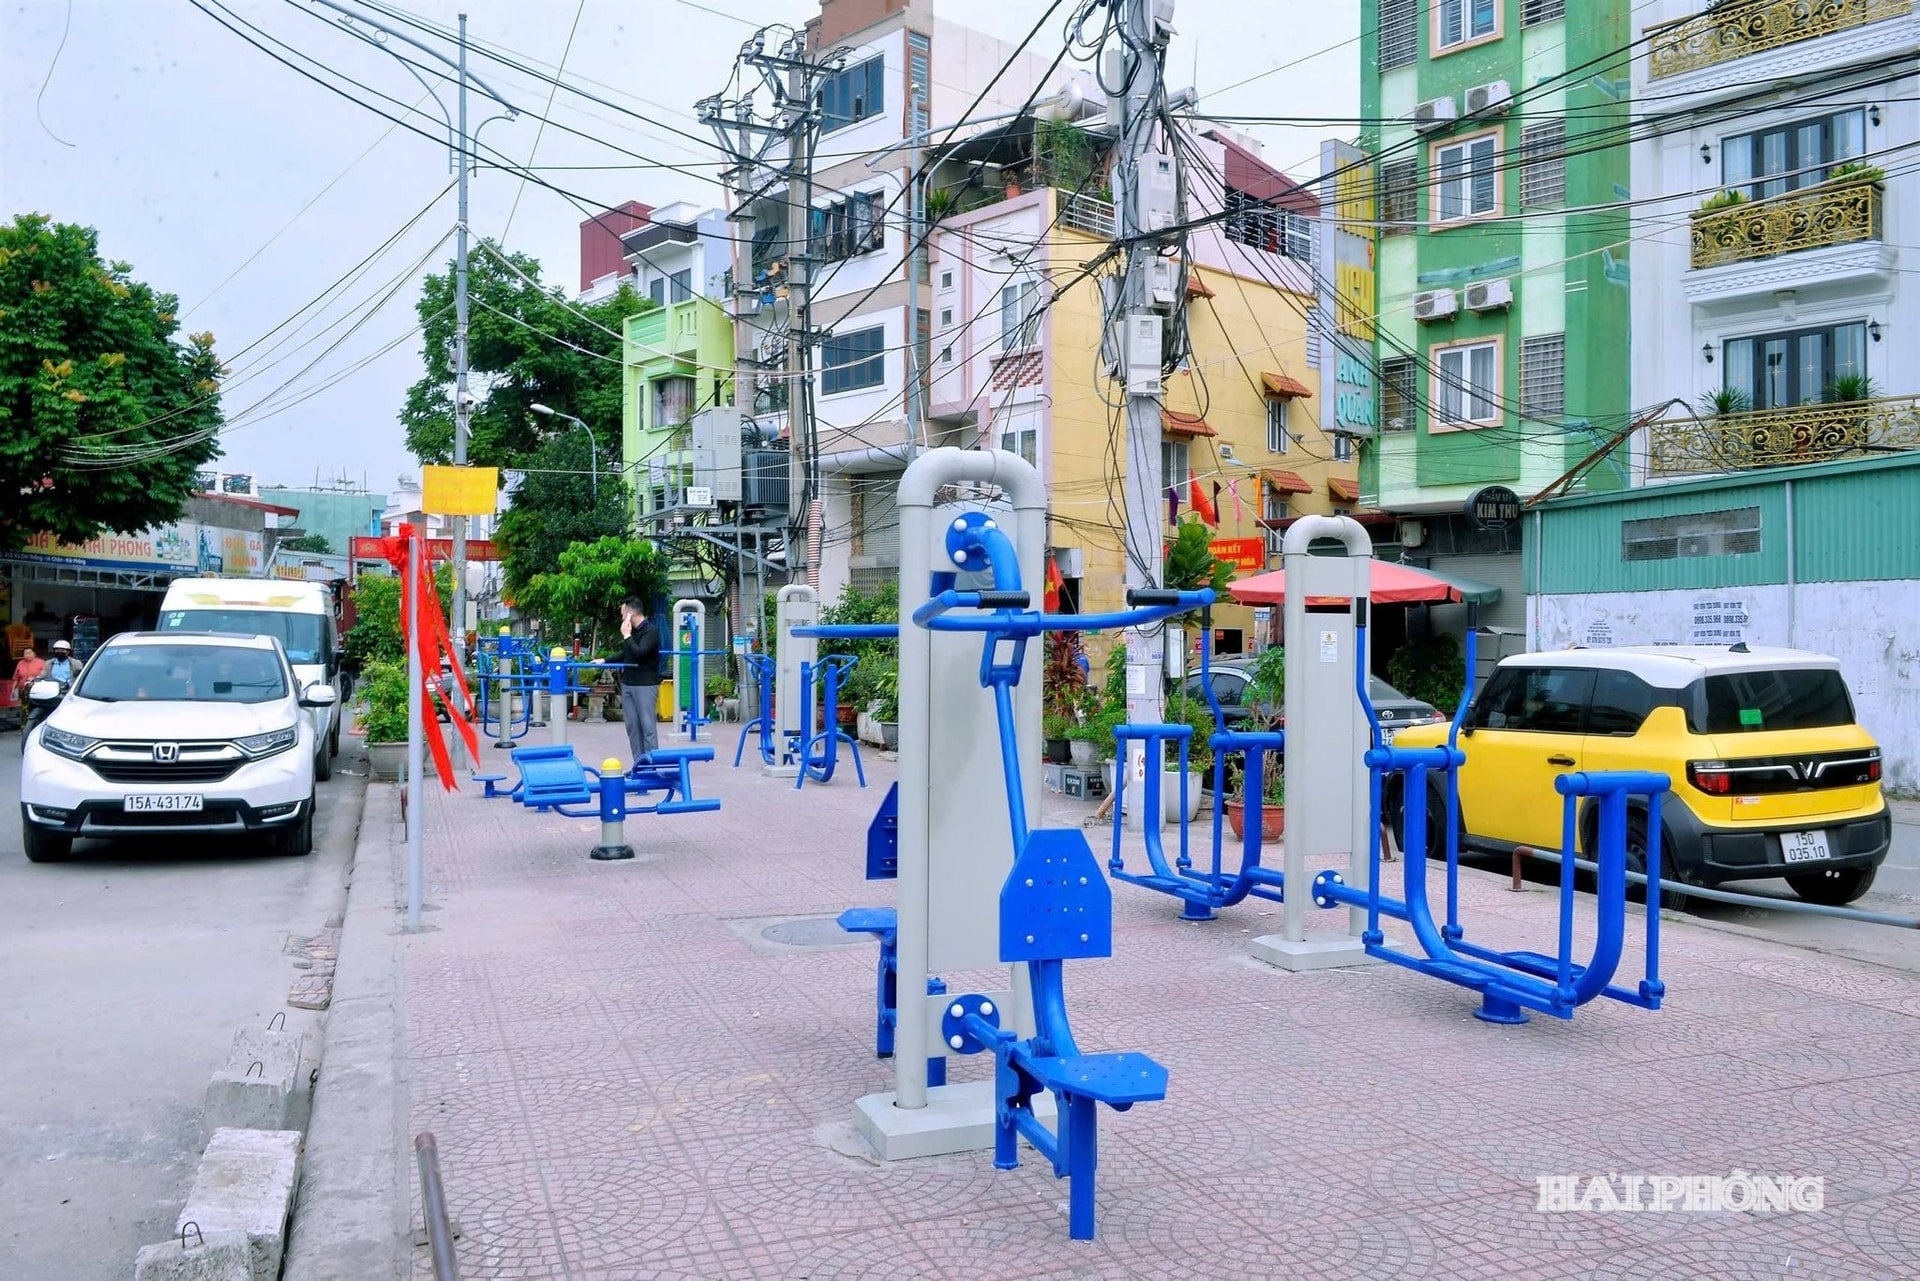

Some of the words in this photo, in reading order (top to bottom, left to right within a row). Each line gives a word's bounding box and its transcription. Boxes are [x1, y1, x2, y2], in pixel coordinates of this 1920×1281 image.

[1476, 503, 1497, 518] KIM
[129, 795, 200, 810] 15A-431.74
[1789, 845, 1826, 861] 035.10
